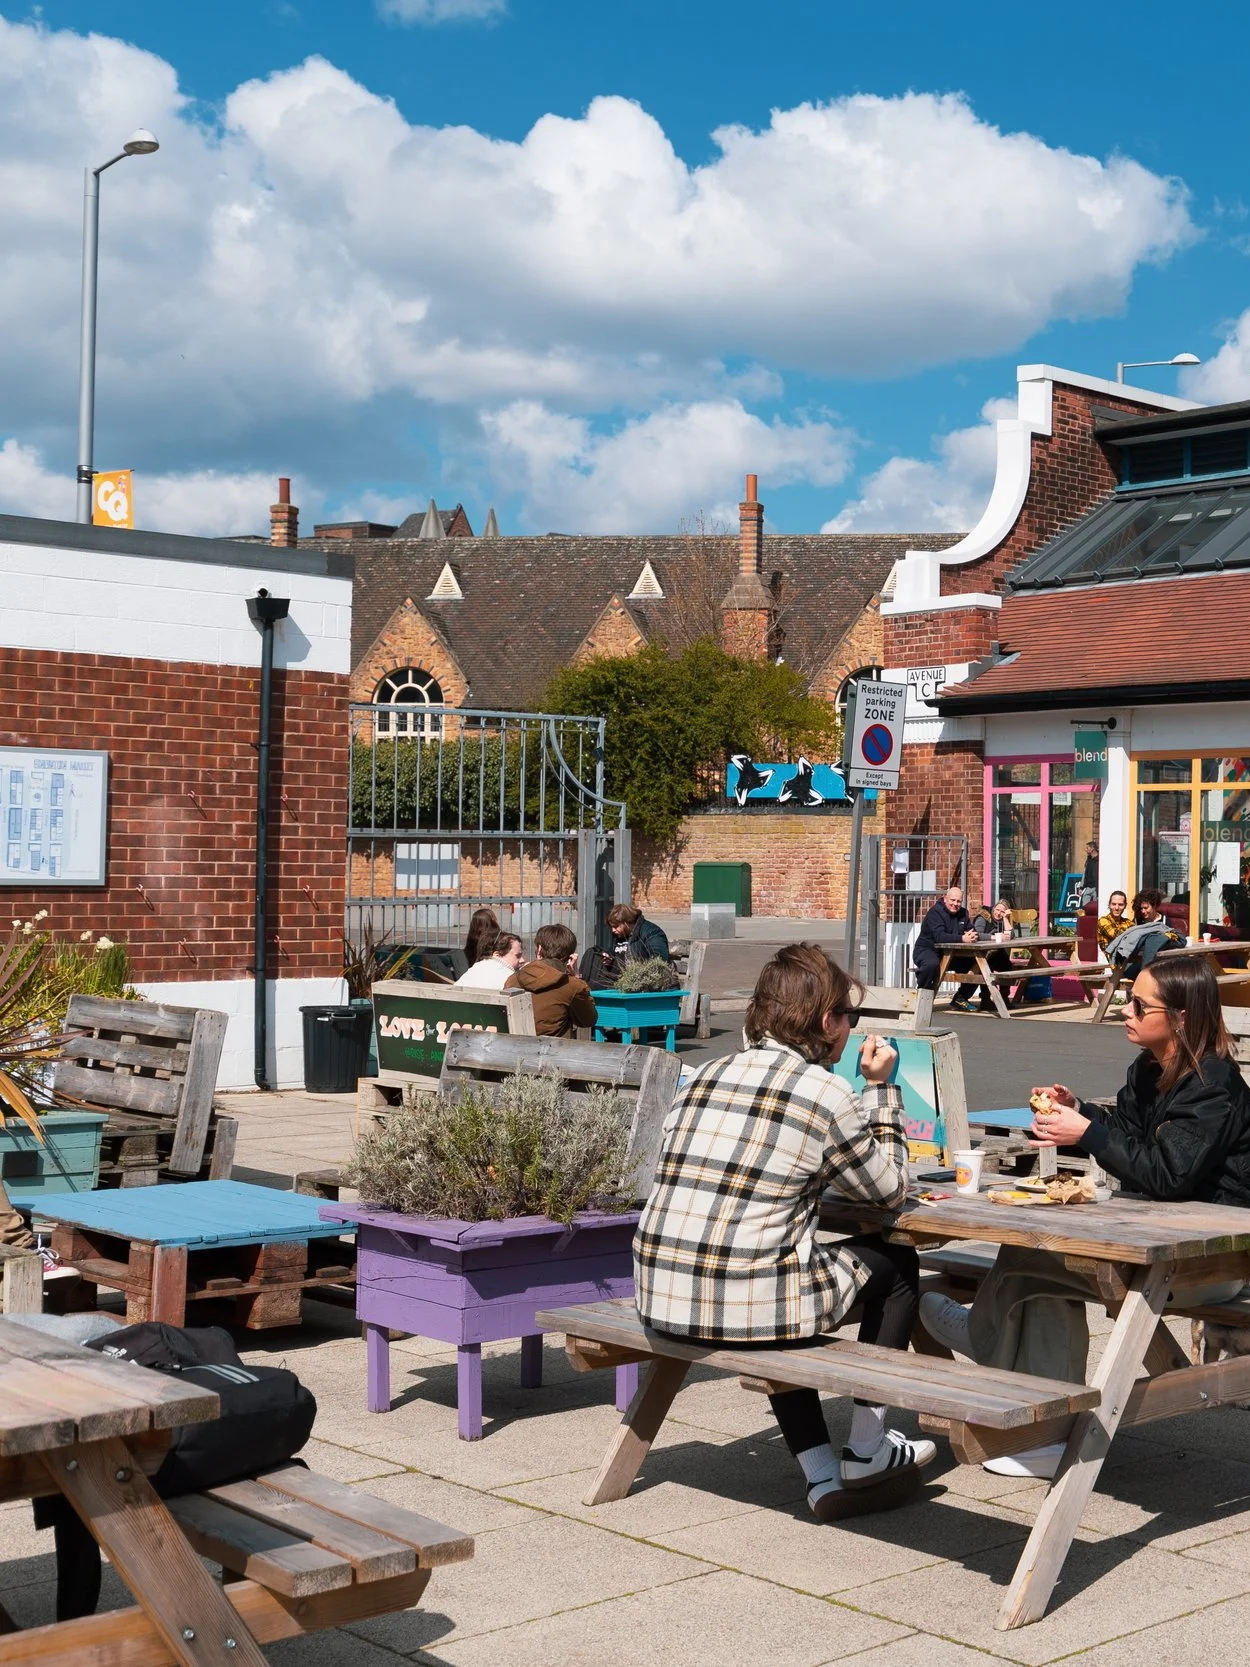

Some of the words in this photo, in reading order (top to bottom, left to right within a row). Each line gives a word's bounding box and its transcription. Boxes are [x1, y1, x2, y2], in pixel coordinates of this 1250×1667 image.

[910, 669, 943, 681] AVENUE
[861, 684, 903, 697] Restricted
[922, 683, 931, 697] C
[866, 697, 896, 709] parking
[864, 708, 894, 721] ZONE
[1075, 748, 1108, 762] blend
[379, 1014, 425, 1041] LOVE
